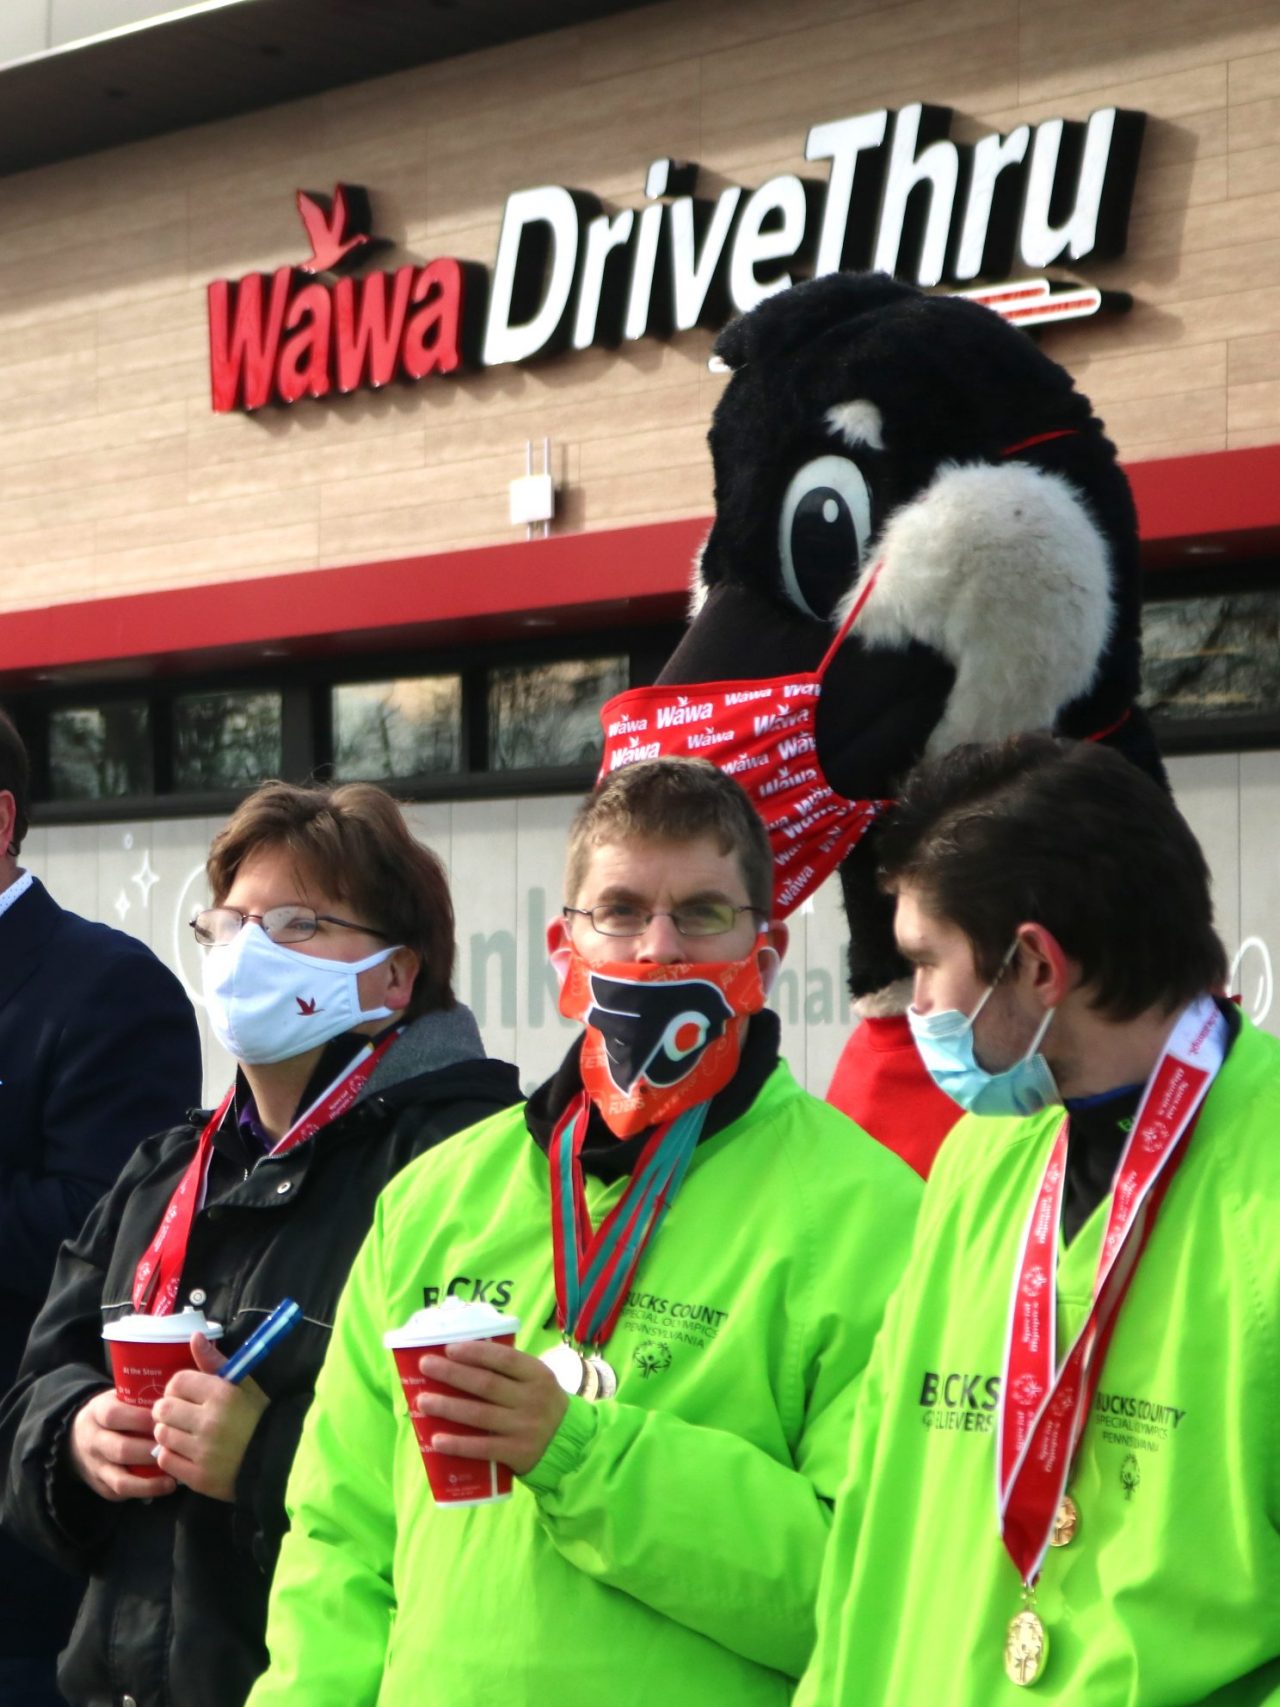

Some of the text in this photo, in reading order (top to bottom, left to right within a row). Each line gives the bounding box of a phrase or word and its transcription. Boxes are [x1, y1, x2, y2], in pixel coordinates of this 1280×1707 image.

[207, 102, 1120, 415] Wawa DriveThru
[608, 718, 648, 738] Wawa
[656, 702, 713, 729] Wawa
[687, 730, 735, 749] Wawa
[610, 741, 661, 771] Wawa
[777, 866, 815, 906] Wawa
[423, 1276, 514, 1309] BCKS
[670, 1303, 729, 1328] COUNT
[920, 1372, 1001, 1412] BCKS
